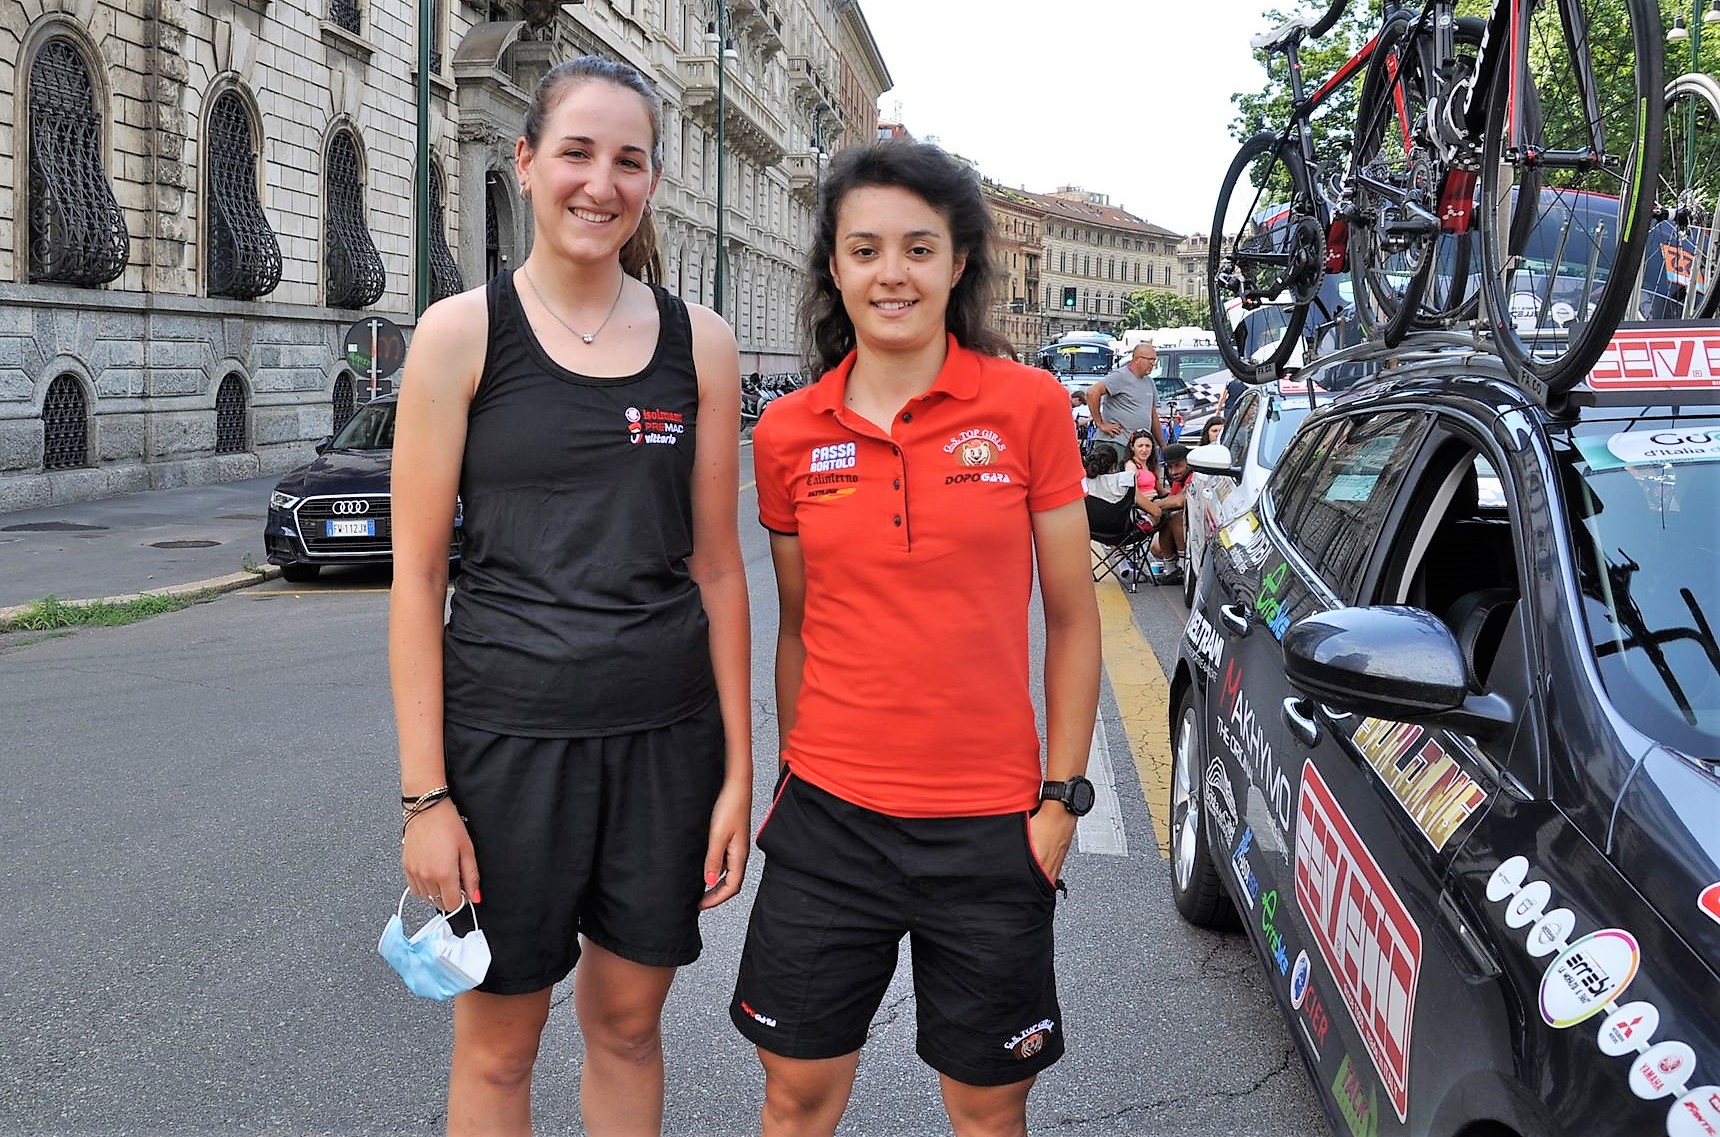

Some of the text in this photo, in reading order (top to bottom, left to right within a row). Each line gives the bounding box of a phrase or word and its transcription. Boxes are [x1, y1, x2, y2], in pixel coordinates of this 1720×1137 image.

[645, 422, 684, 433] PREMAC
[959, 428, 980, 441] TOP
[981, 429, 1007, 452] GIRLS
[811, 442, 856, 463] FASSA
[1644, 446, 1706, 457] d'Italia
[809, 456, 856, 473] BORTOLO
[944, 472, 1011, 485] DOPOGARA
[1220, 657, 1291, 832] MAKHYMO
[1639, 1062, 1665, 1092] YAMAHA
